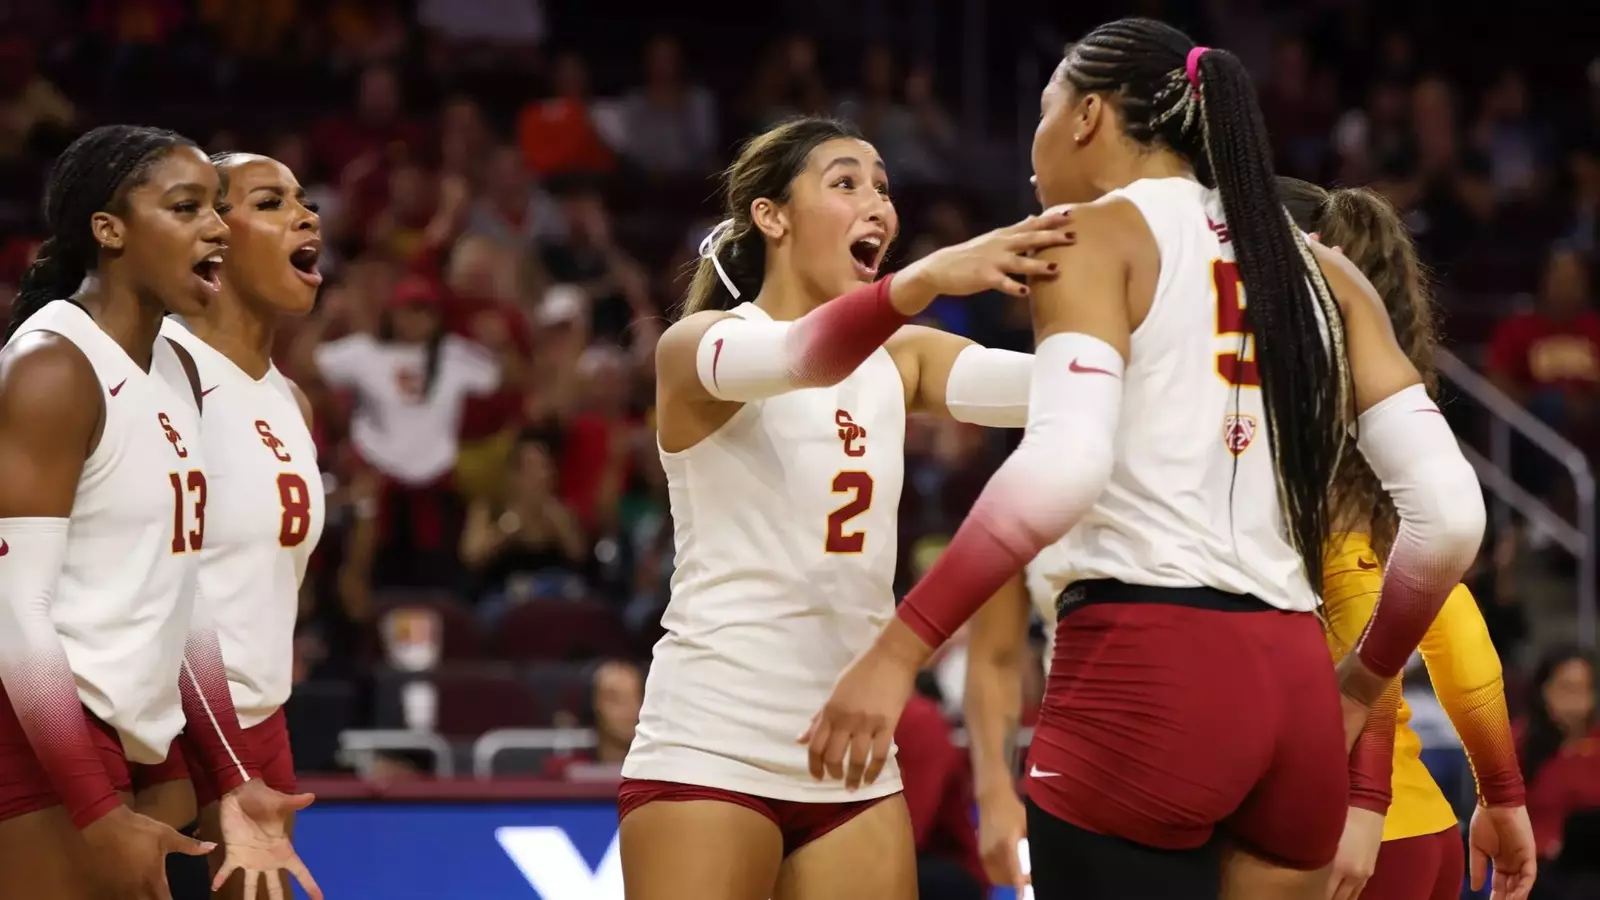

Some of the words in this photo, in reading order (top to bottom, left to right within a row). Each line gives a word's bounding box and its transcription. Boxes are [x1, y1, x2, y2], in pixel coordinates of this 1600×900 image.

[1210, 257, 1262, 389] 5
[158, 412, 188, 459] SC
[254, 420, 292, 463] SC
[835, 409, 866, 457] SC
[169, 469, 208, 555] 13
[276, 472, 311, 548] 8
[824, 469, 875, 554] 2
